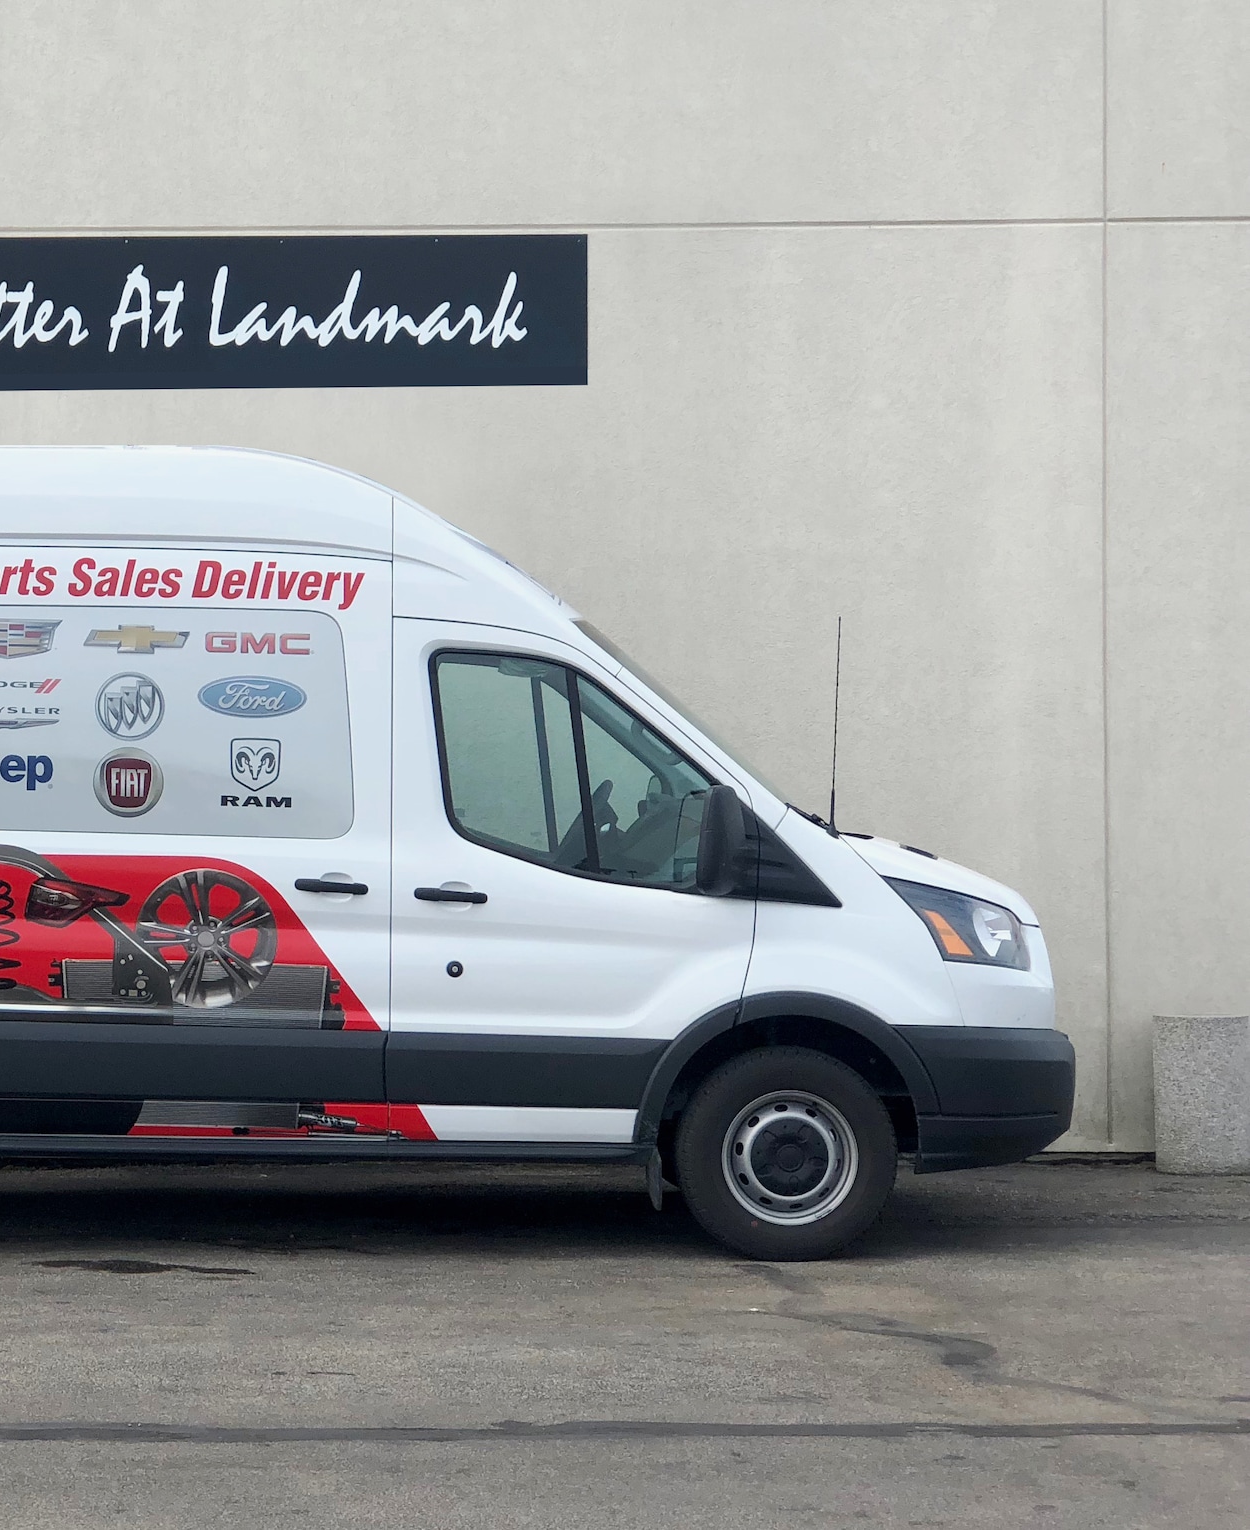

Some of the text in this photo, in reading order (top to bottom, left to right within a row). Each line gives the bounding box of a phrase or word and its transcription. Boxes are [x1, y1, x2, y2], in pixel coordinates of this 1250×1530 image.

[107, 264, 184, 352] At
[210, 265, 528, 349] Landmark
[67, 559, 183, 600] Sales
[191, 562, 365, 610] Delivery
[204, 631, 311, 656] GMC
[218, 682, 287, 711] Ford
[111, 768, 149, 798] FIAT
[220, 795, 292, 808] RAM
